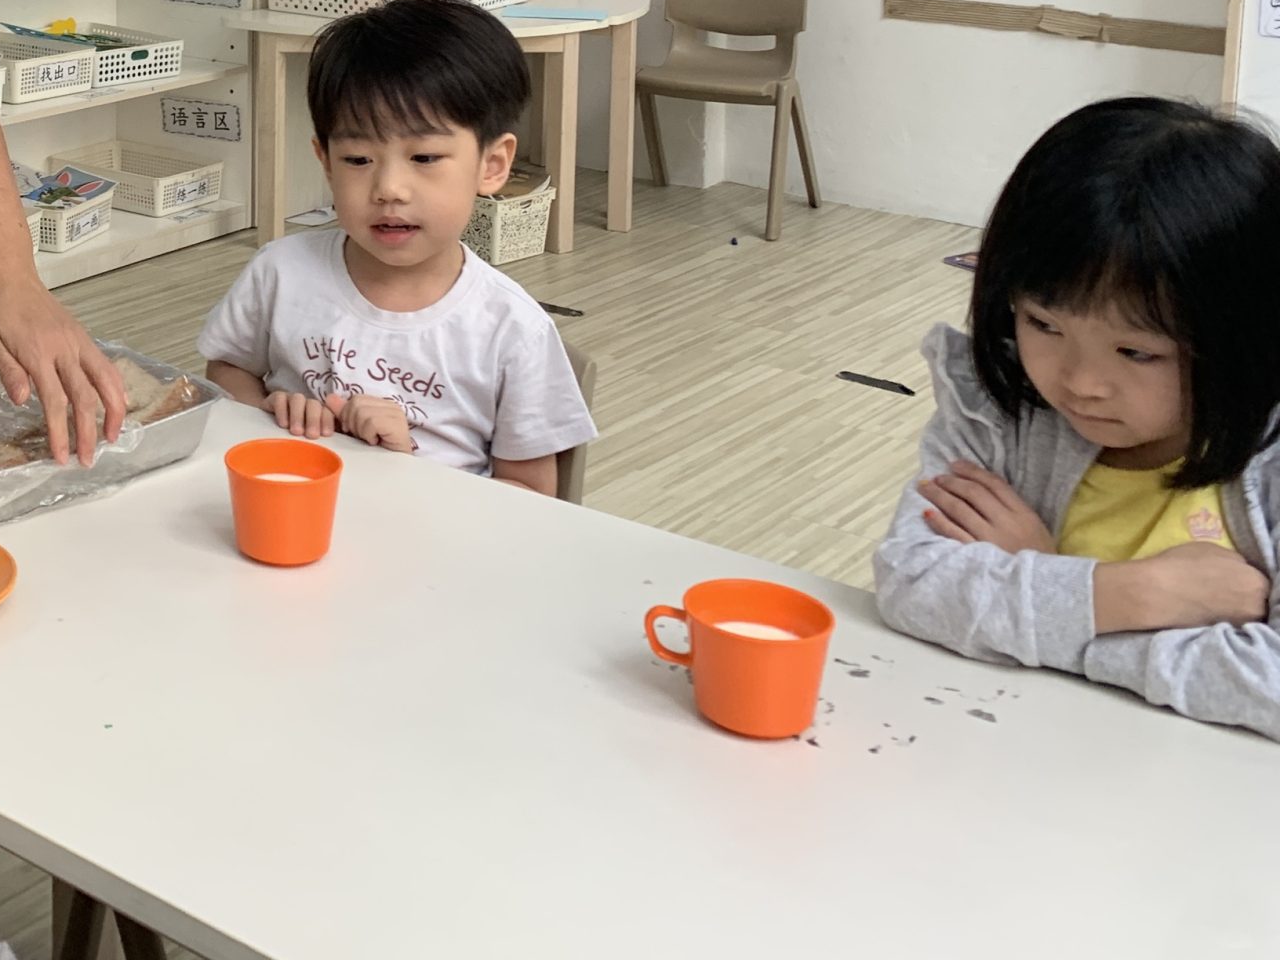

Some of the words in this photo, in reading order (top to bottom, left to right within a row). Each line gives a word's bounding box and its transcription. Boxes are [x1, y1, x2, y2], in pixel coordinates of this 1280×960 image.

[39, 64, 78, 83] 找出口
[170, 106, 231, 132] 语言区
[302, 336, 357, 370] Little
[367, 357, 446, 400] Seeds
